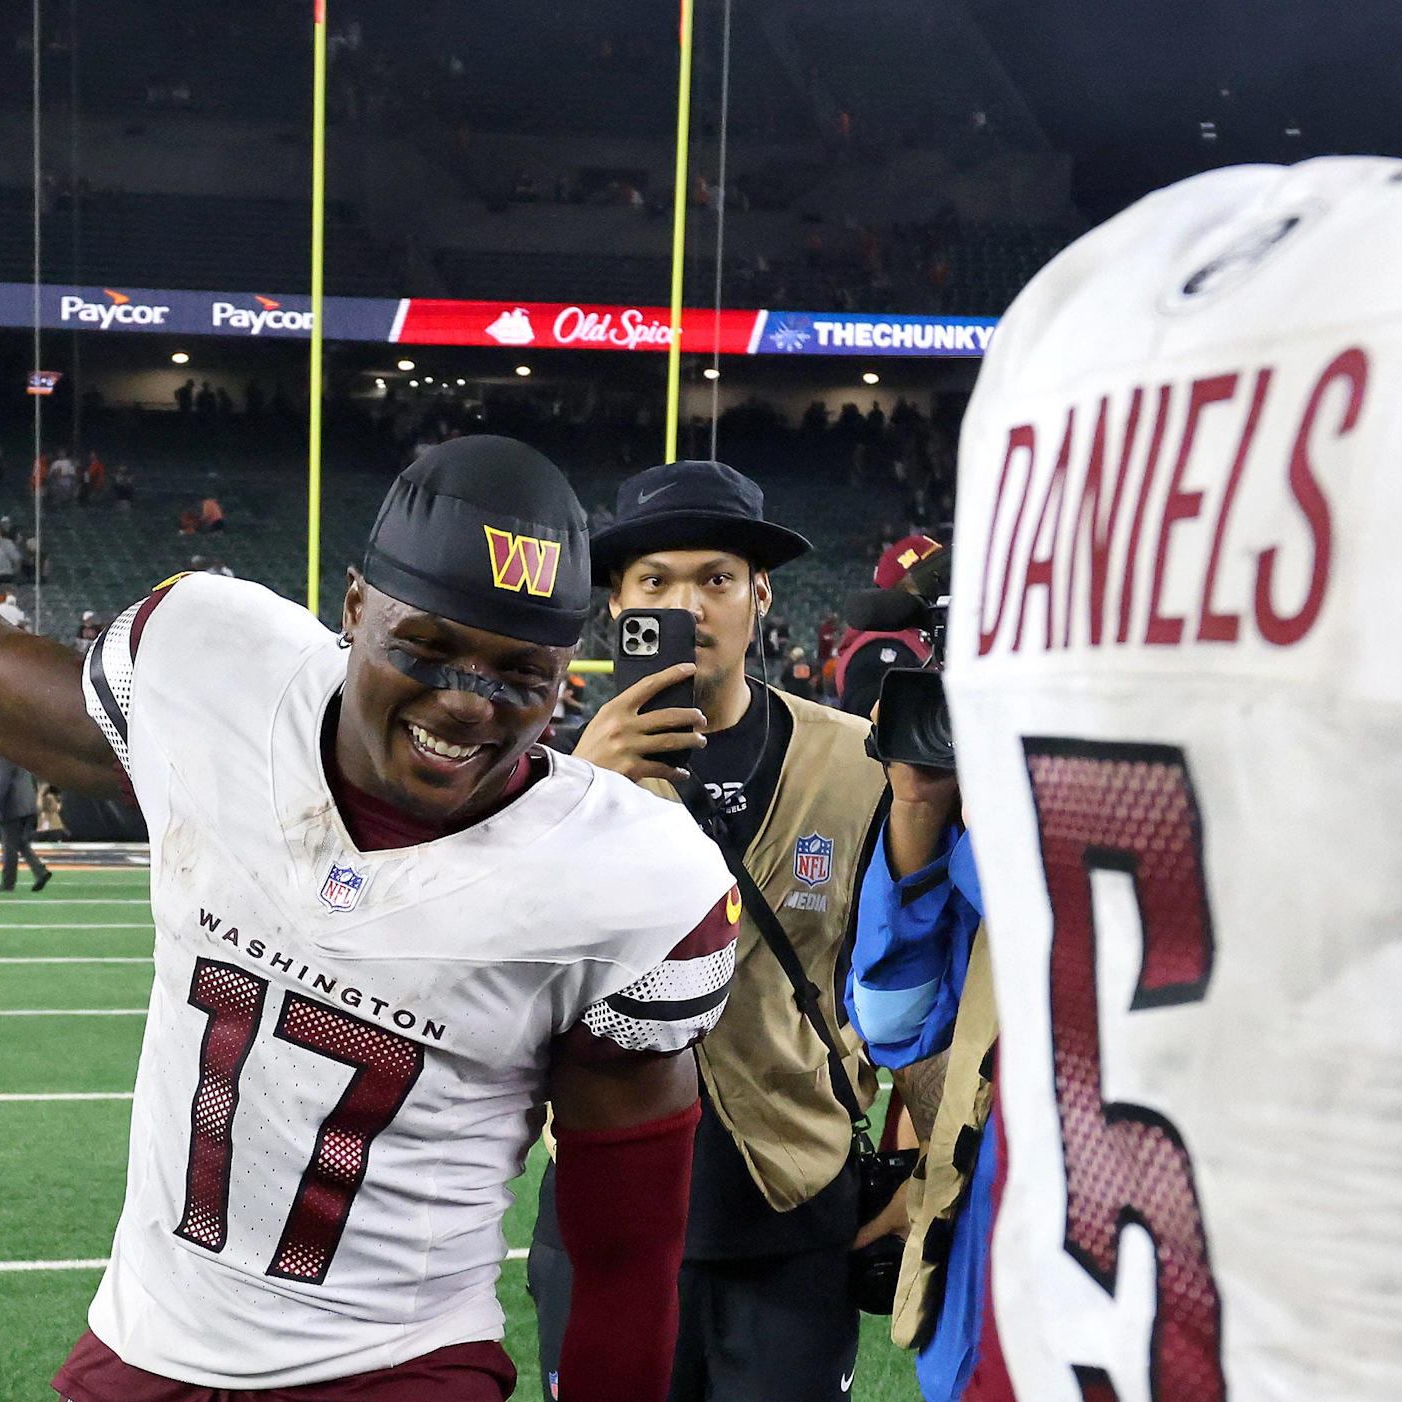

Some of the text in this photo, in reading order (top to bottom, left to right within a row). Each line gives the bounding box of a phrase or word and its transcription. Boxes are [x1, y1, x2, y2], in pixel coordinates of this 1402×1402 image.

[60, 296, 170, 329] Paycor
[553, 306, 609, 343] Old
[976, 346, 1370, 658] DANIELS
[798, 854, 827, 881] NFL
[324, 880, 352, 905] NFL
[783, 890, 828, 913] MEDIA
[197, 907, 448, 1041] WASHINGTON
[173, 956, 425, 1286] 17
